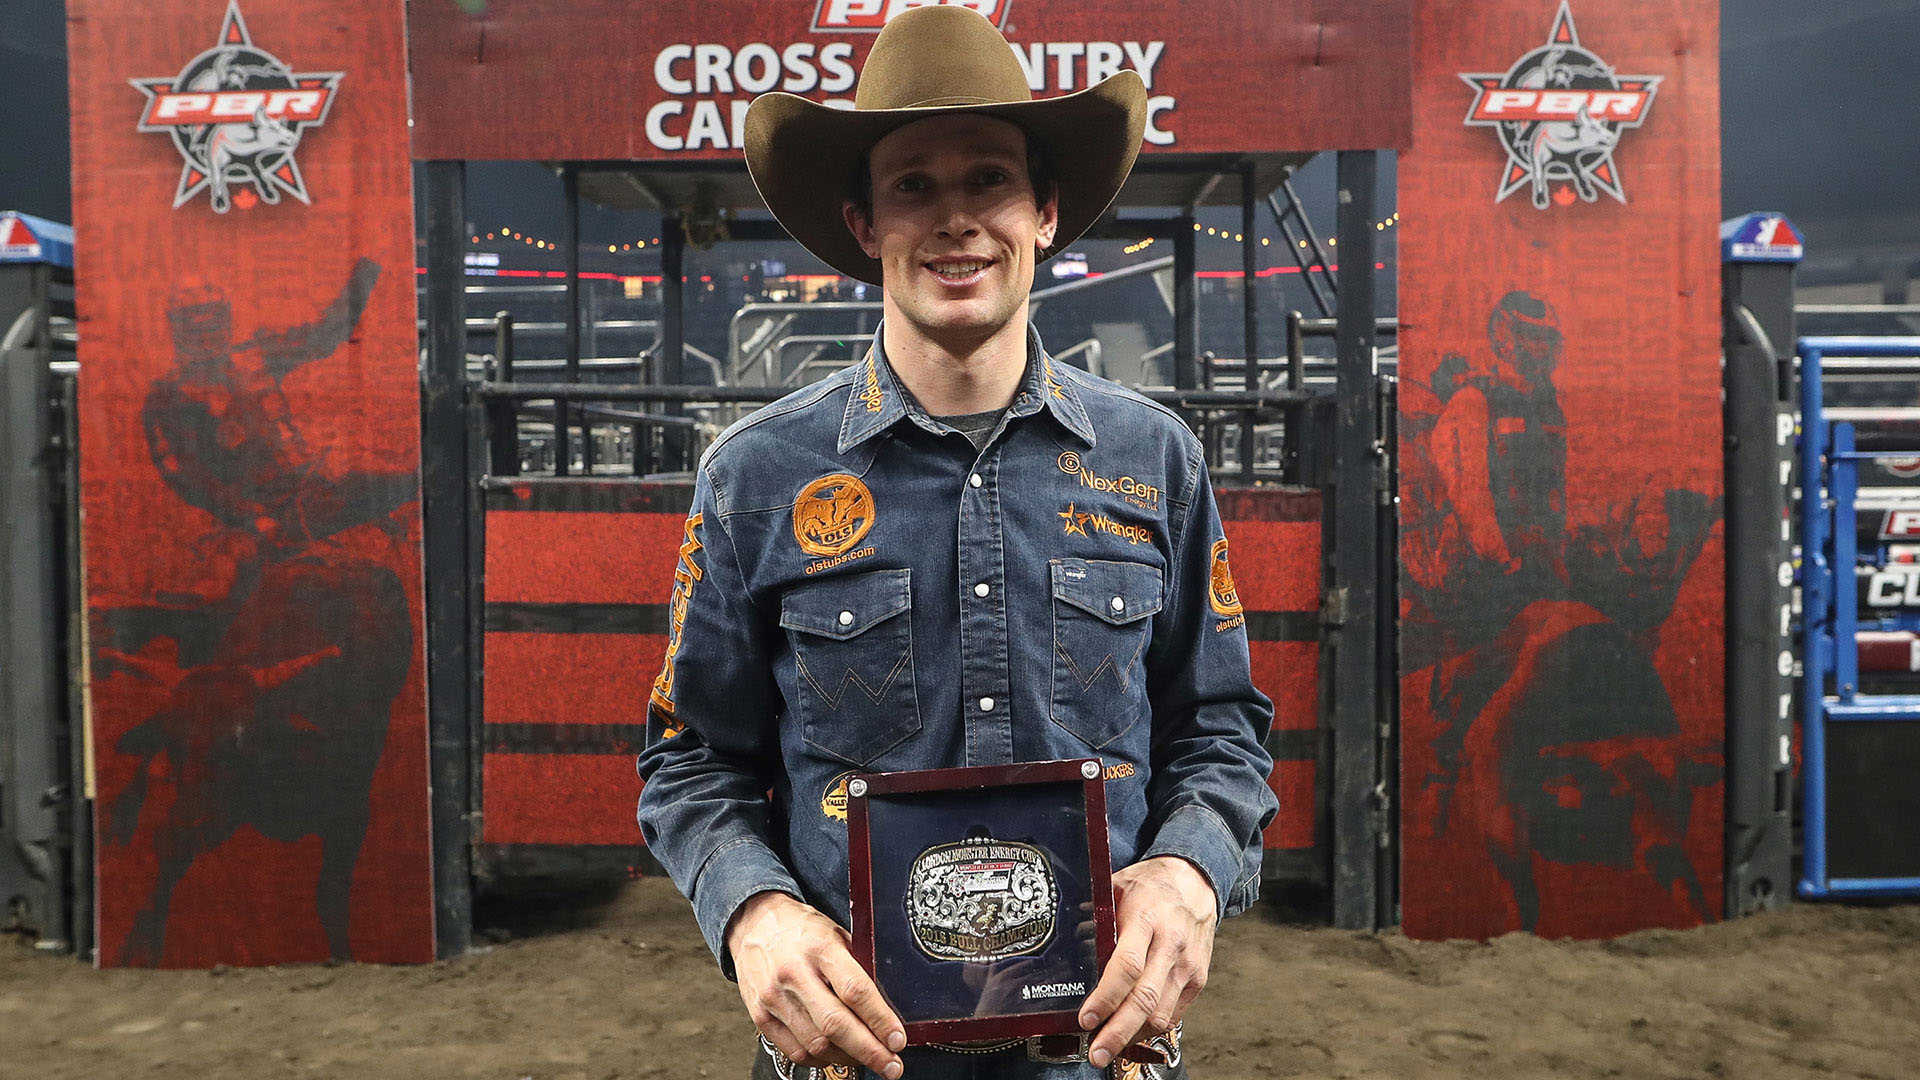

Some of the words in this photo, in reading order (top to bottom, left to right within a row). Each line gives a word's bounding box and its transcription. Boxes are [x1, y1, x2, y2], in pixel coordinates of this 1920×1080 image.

[654, 42, 856, 95] CROSS
[1009, 41, 1165, 91] NTRY
[156, 91, 322, 118] PBR
[1484, 92, 1640, 114] PBR
[1080, 467, 1159, 503] NexGen
[1089, 513, 1154, 545] Wrangler
[805, 545, 876, 575] olstubs.com
[1103, 763, 1135, 780] UCKERS
[989, 846, 1020, 860] ENERGY
[1031, 982, 1085, 994] MONTANA
